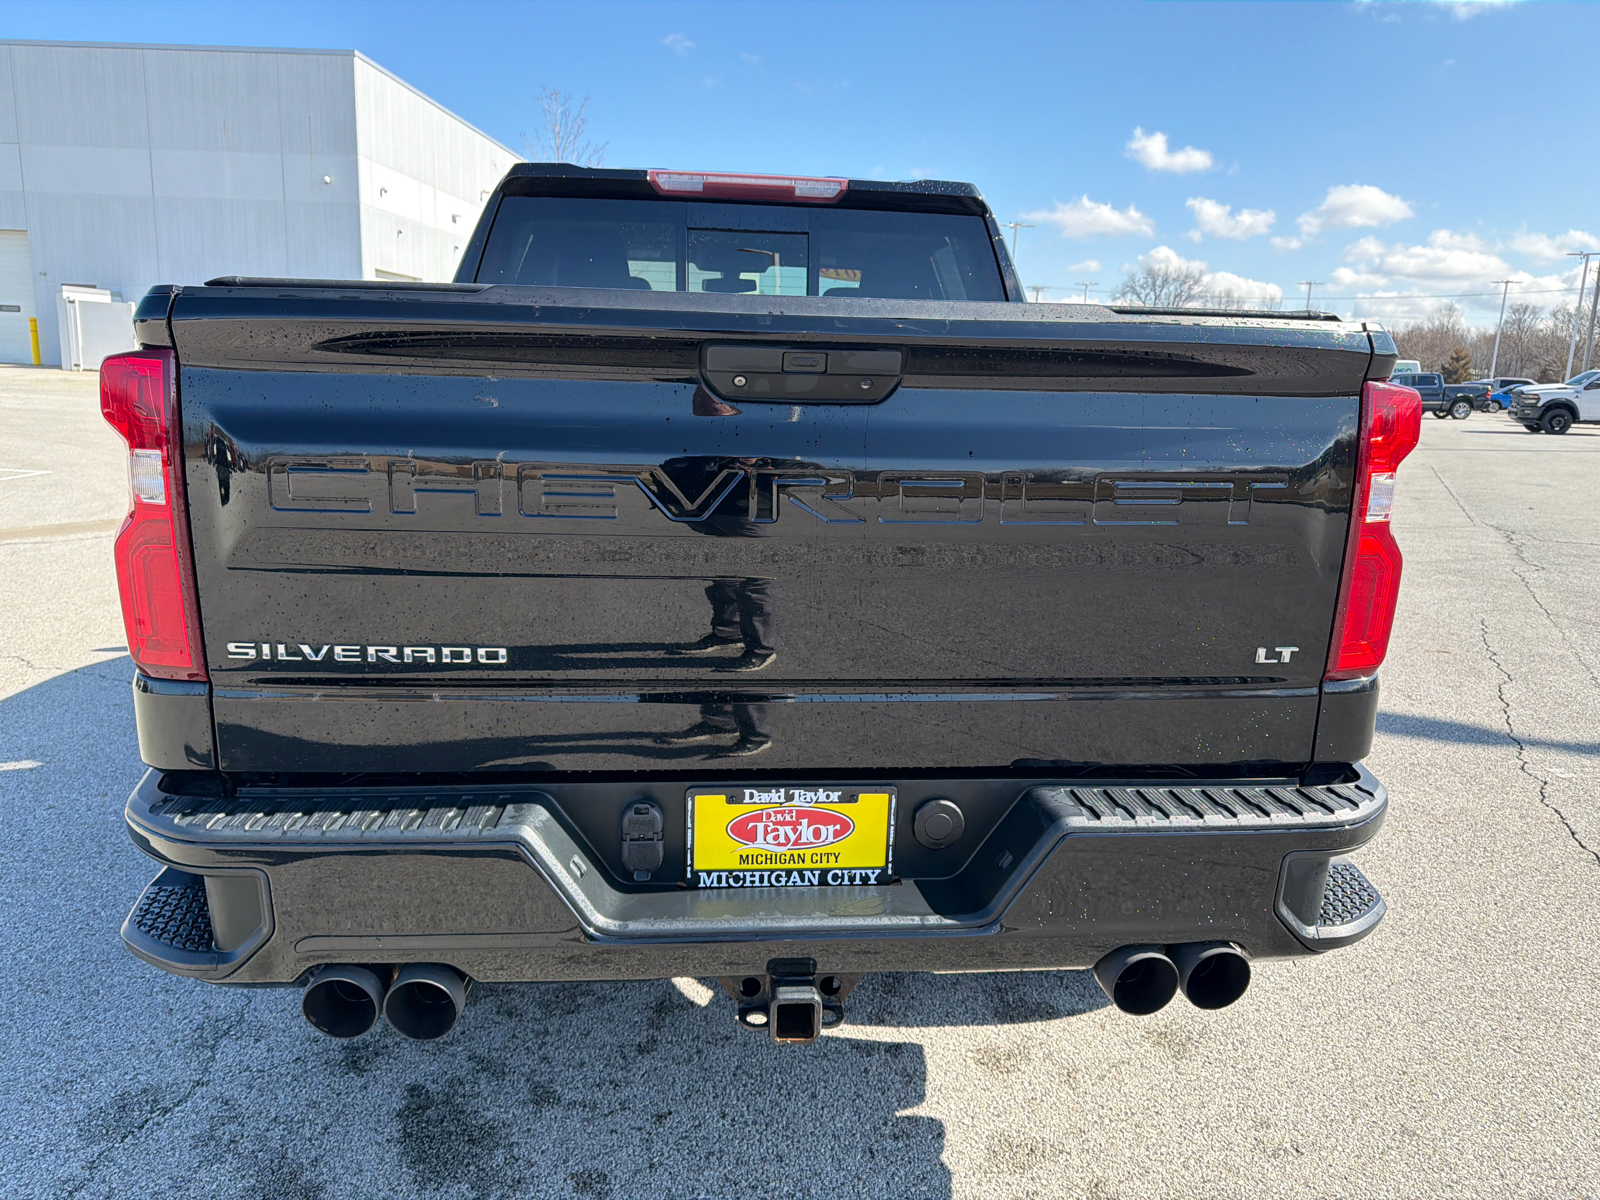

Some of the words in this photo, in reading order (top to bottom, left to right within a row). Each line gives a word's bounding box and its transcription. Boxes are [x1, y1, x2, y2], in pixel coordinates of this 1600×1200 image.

[266, 455, 1290, 526] CHEVROLET
[226, 642, 508, 664] SILVERADO
[1255, 647, 1300, 663] LT
[743, 788, 785, 804] David
[788, 788, 842, 806] Taylor
[762, 809, 796, 822] David
[746, 818, 841, 852] Taylor
[739, 852, 807, 866] MICHIGAN
[810, 852, 841, 865] CITY
[698, 870, 820, 888] MICHIGAN
[827, 869, 882, 886] CITY
